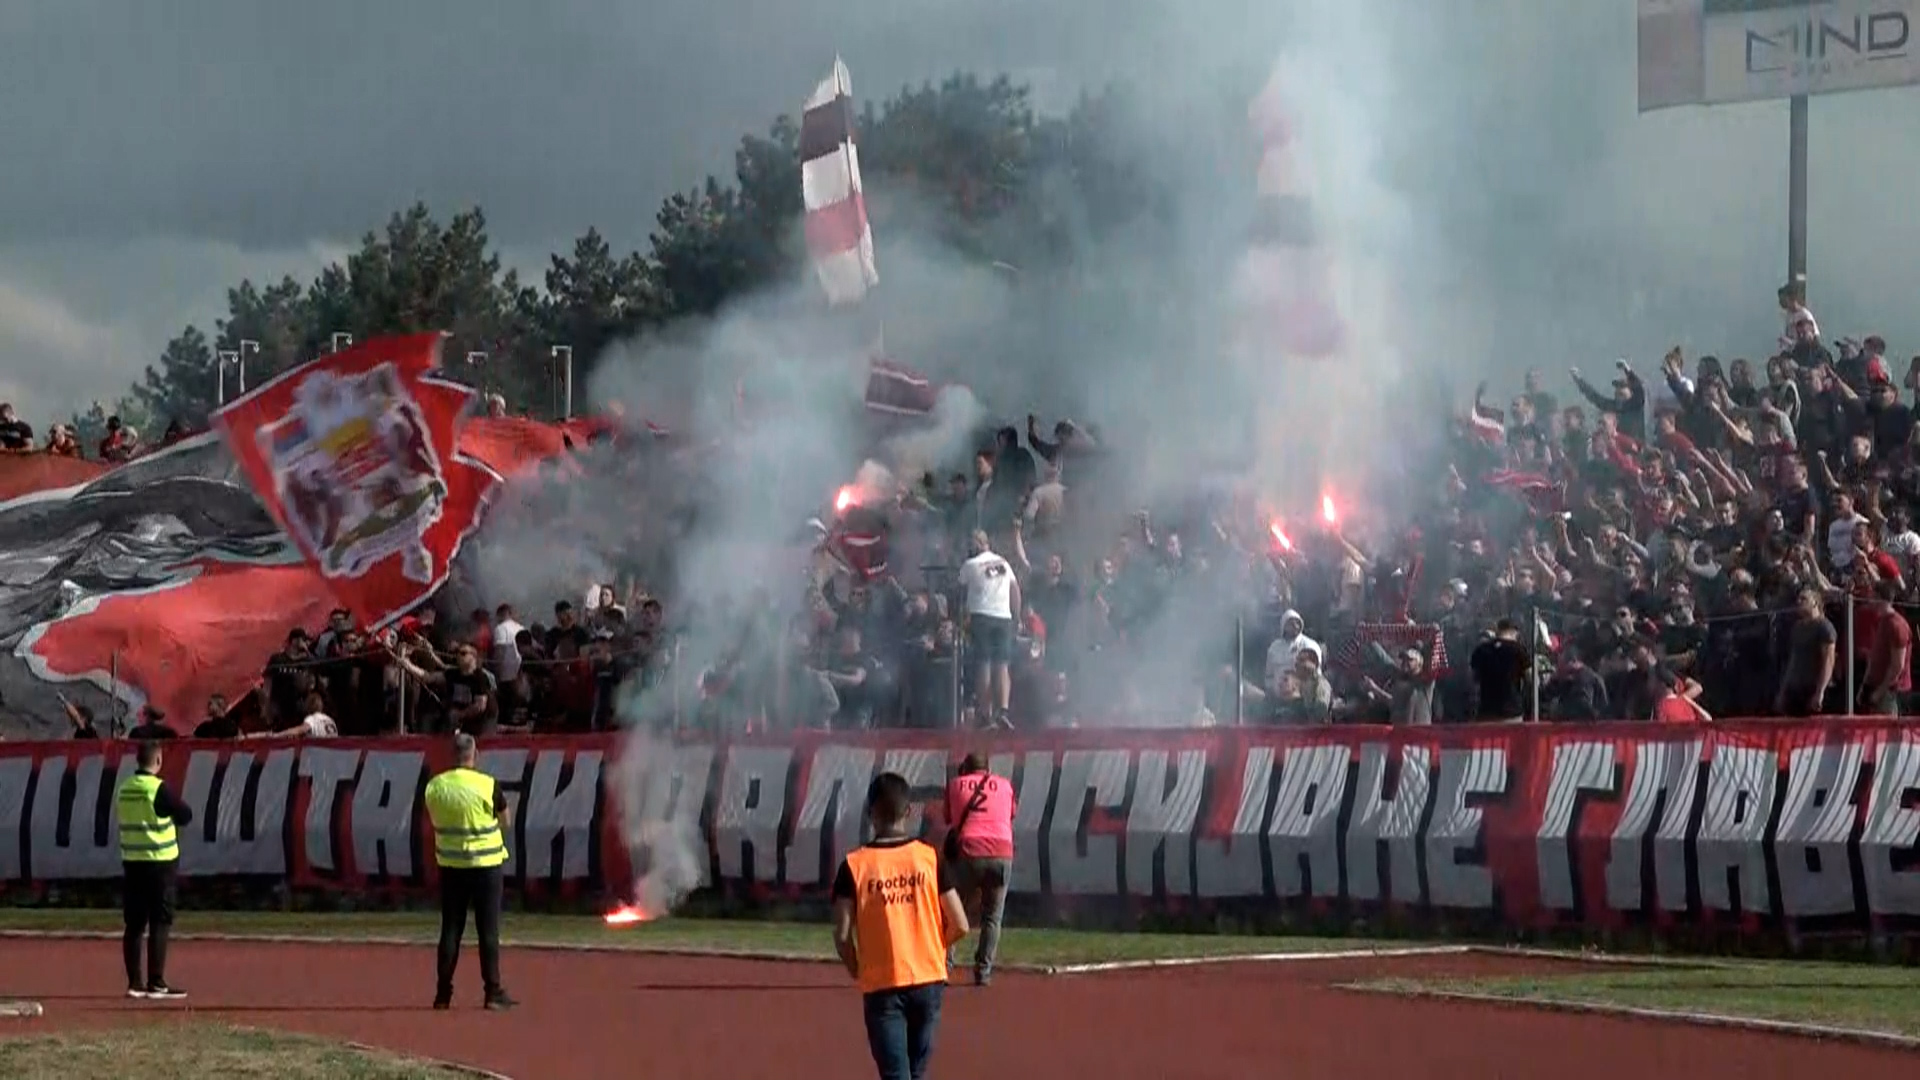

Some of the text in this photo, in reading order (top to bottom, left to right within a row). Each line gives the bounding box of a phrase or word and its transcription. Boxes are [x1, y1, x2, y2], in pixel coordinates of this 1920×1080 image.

[1746, 12, 1909, 72] MIND
[177, 748, 426, 877] ШТА
[968, 791, 988, 812] 2
[867, 871, 926, 893] Football
[882, 892, 914, 905] Wire
